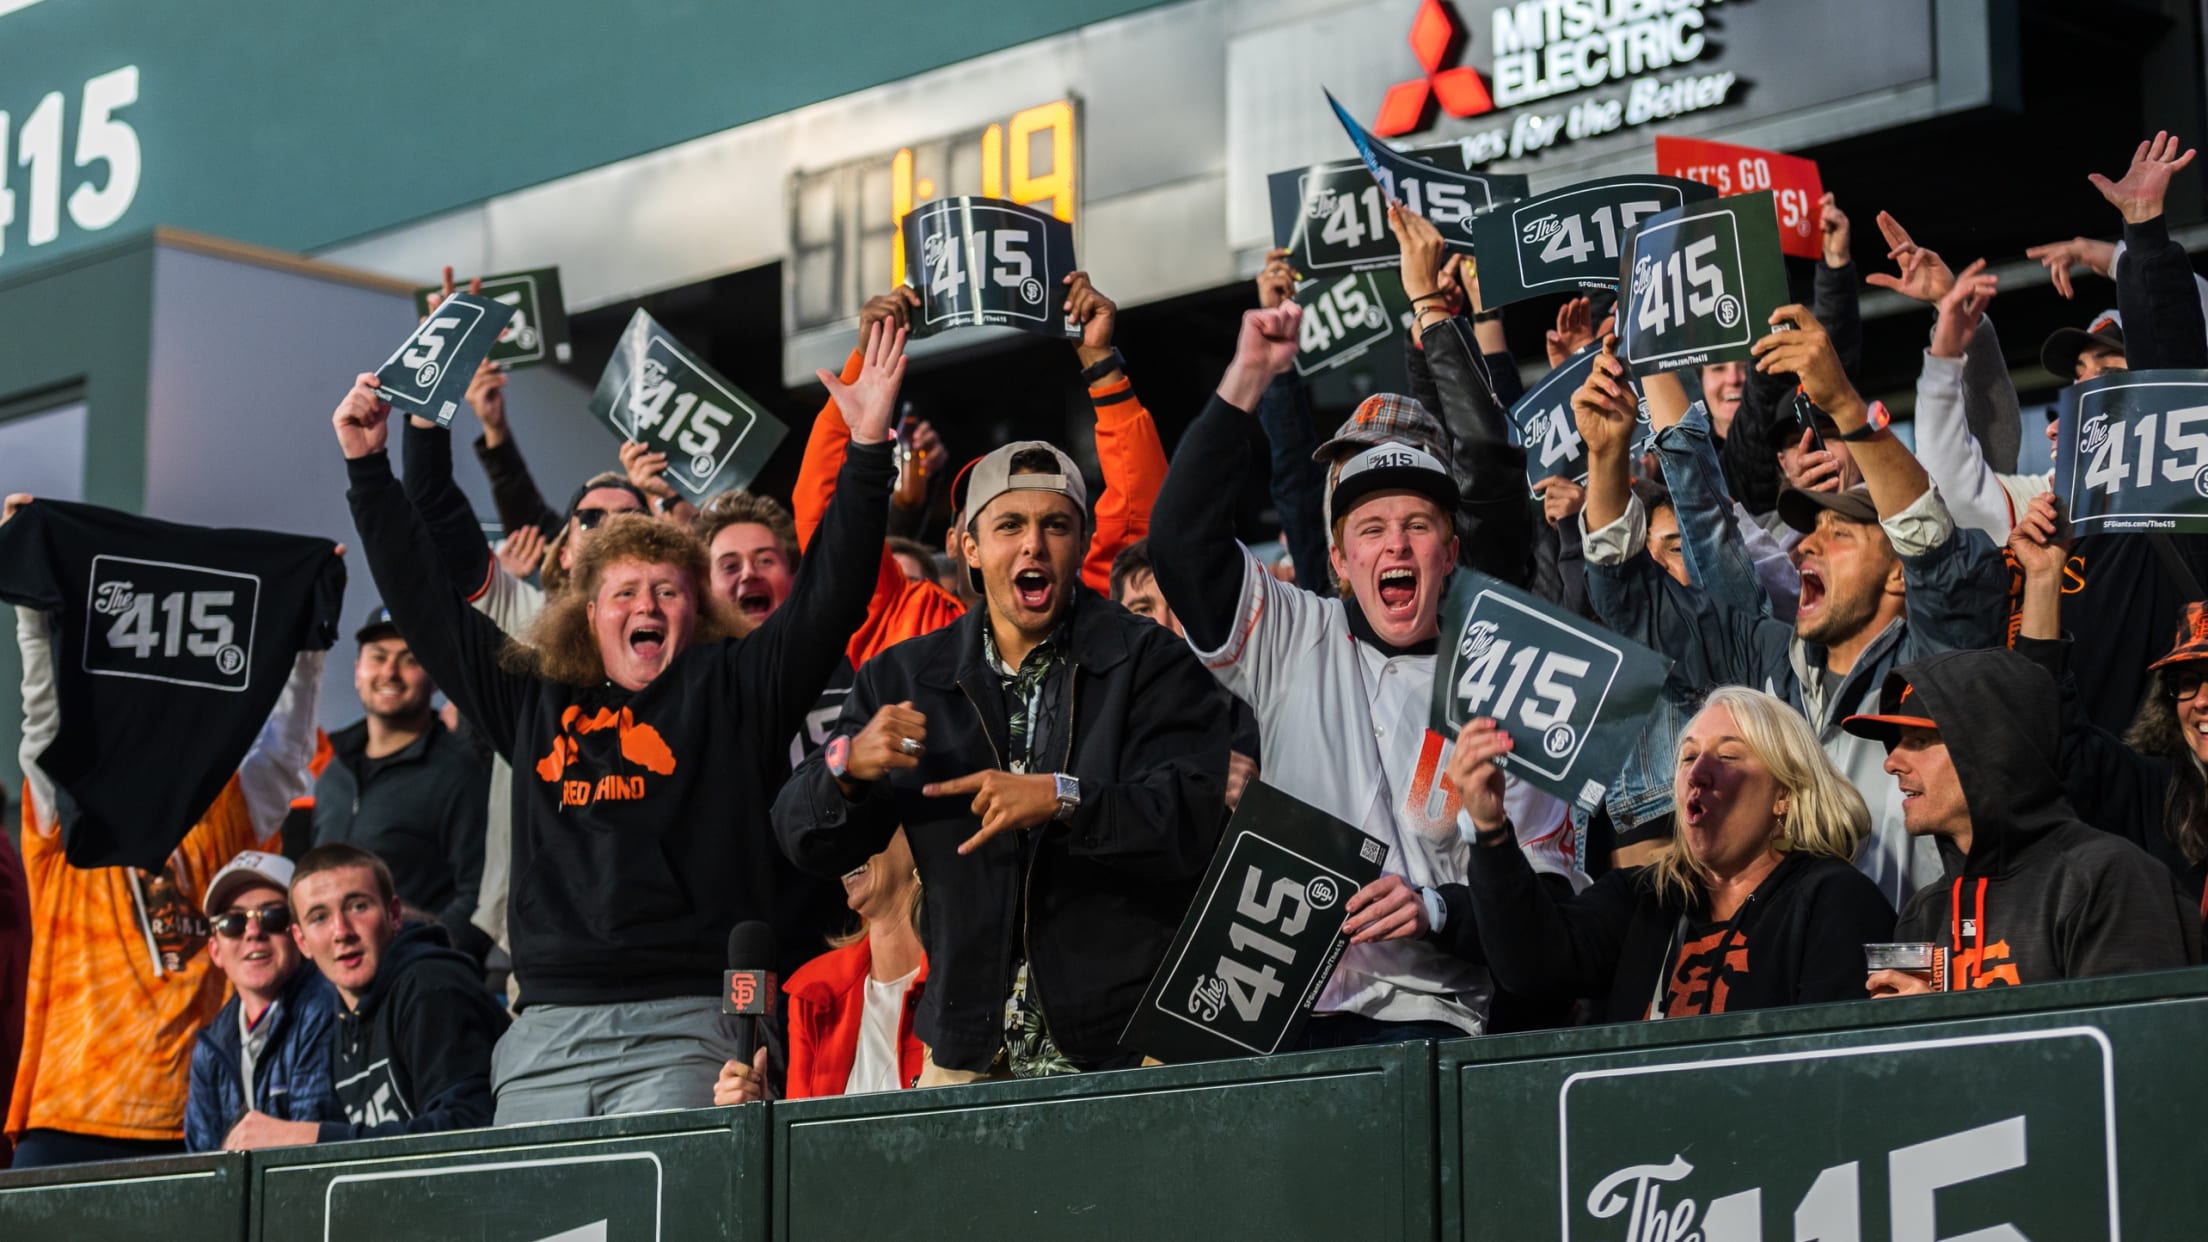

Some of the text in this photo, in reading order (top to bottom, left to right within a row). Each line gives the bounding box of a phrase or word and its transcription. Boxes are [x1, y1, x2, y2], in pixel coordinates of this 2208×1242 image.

[1492, 0, 1722, 55] MITSUB
[1493, 7, 1705, 108] ELECTRIC
[1509, 112, 1565, 158] for
[1566, 98, 1622, 140] the
[1625, 71, 1735, 125] Better
[0, 64, 141, 256] 15
[1738, 158, 1771, 190] GO
[1321, 185, 1385, 248] 41
[1523, 213, 1562, 244] The
[931, 229, 1033, 298] 415
[1638, 235, 1725, 337] 415
[1299, 272, 1369, 353] 415
[628, 379, 734, 457] 415
[1524, 408, 1551, 448] The
[2080, 405, 2208, 495] The 415
[95, 581, 235, 659] The 415
[1457, 620, 1591, 732] The 415
[563, 780, 591, 806] RED
[1188, 864, 1312, 1022] The 415
[1586, 1153, 1700, 1242] The
